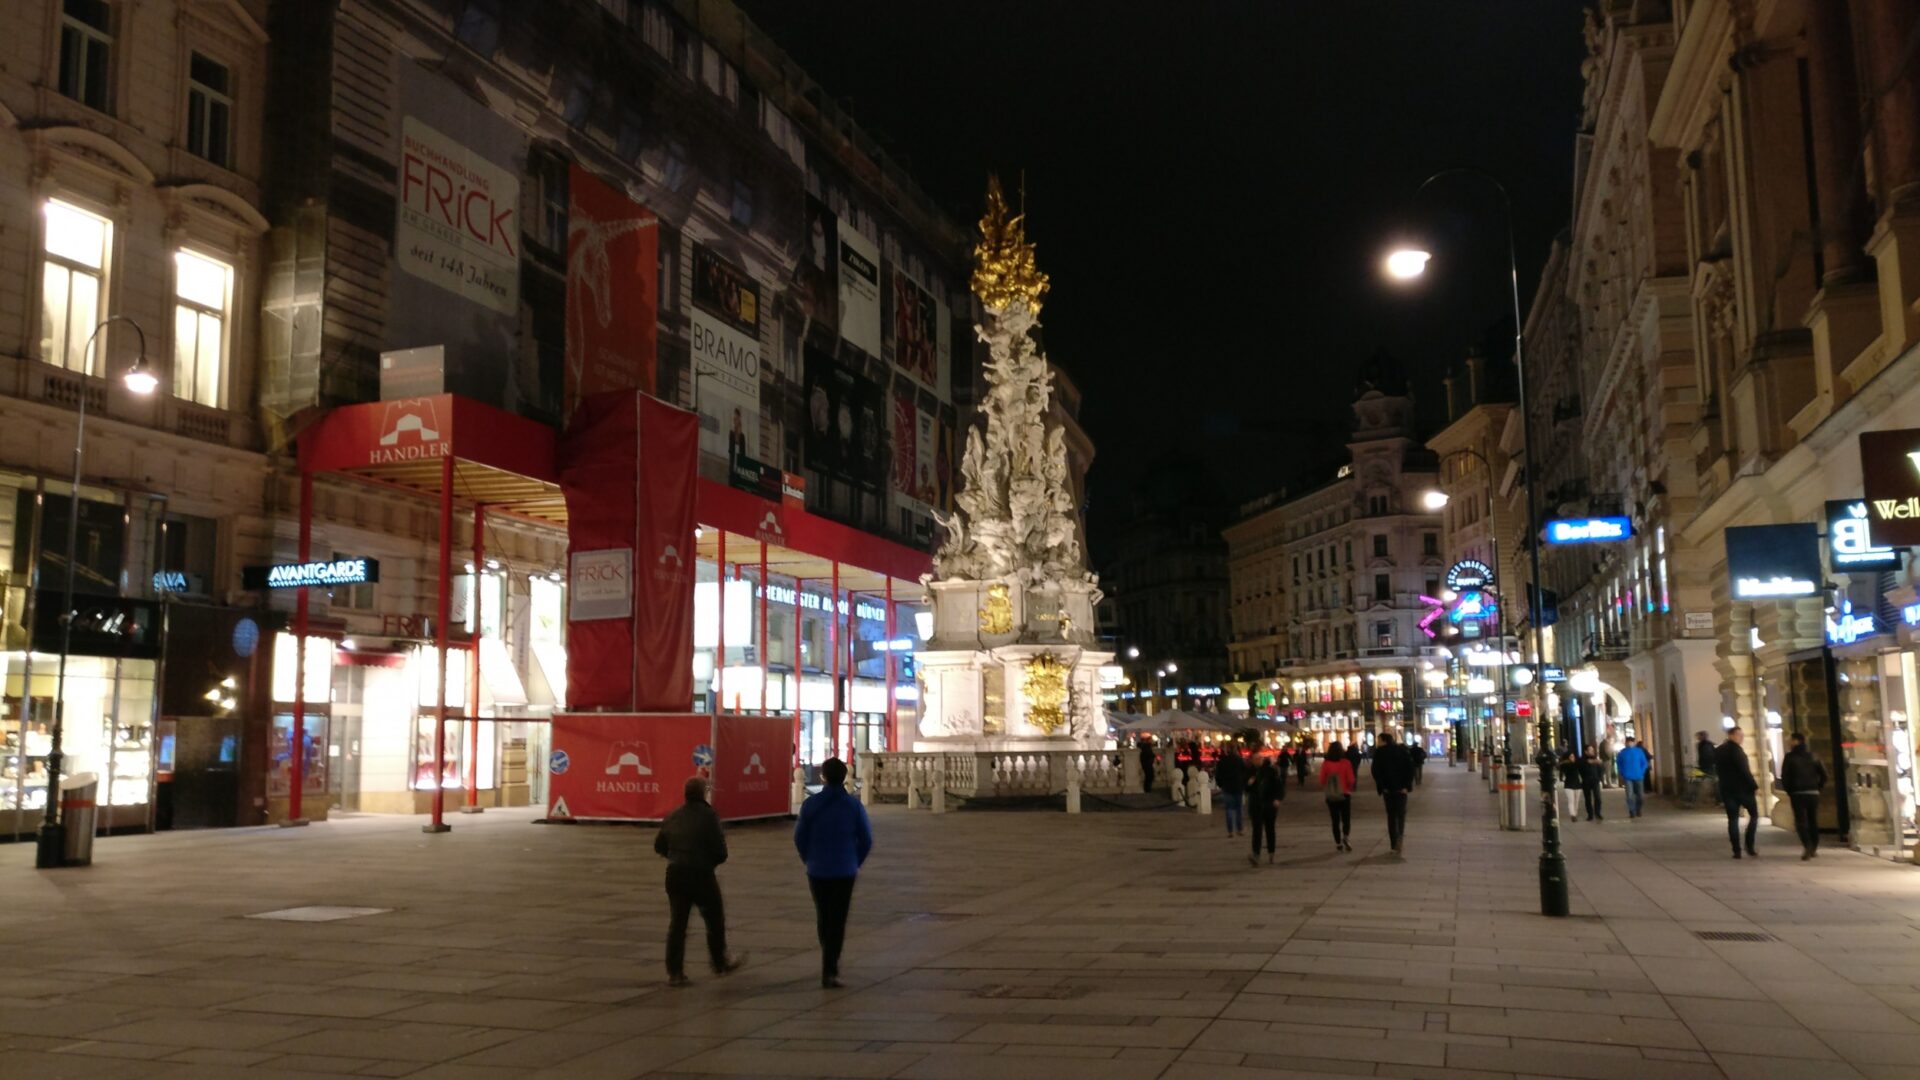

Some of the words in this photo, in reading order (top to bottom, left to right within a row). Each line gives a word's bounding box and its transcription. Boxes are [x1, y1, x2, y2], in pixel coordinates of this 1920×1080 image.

[404, 135, 490, 190] BUCHHANDLUNG
[410, 243, 434, 265] seit
[441, 254, 465, 279] 148
[466, 265, 508, 298] Jahren
[694, 321, 758, 378] BRAMO
[369, 442, 450, 465] HANDLER
[1873, 497, 1920, 520] Well
[268, 559, 366, 582] AVANTGARDE
[596, 781, 660, 794] HANDLER
